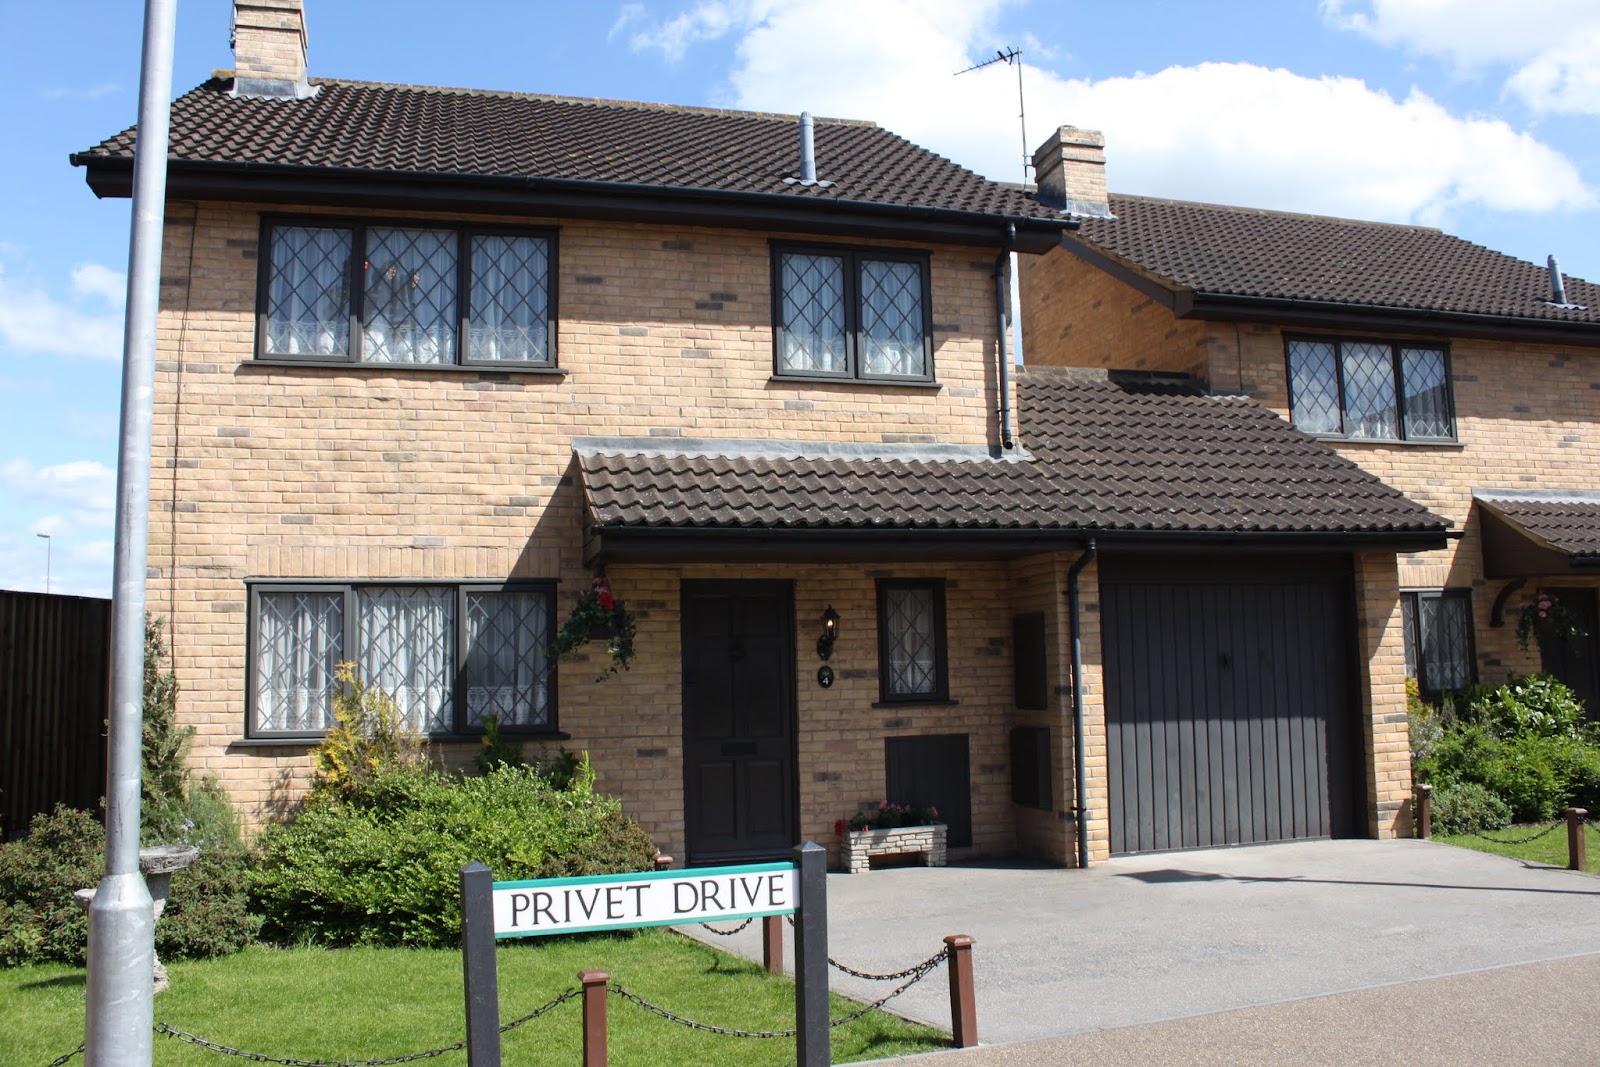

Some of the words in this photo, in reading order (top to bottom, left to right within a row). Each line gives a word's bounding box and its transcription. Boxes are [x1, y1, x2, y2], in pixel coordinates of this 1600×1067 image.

[822, 677, 829, 685] 4
[511, 884, 651, 927] PRIVET
[673, 874, 786, 914] DRIVE
